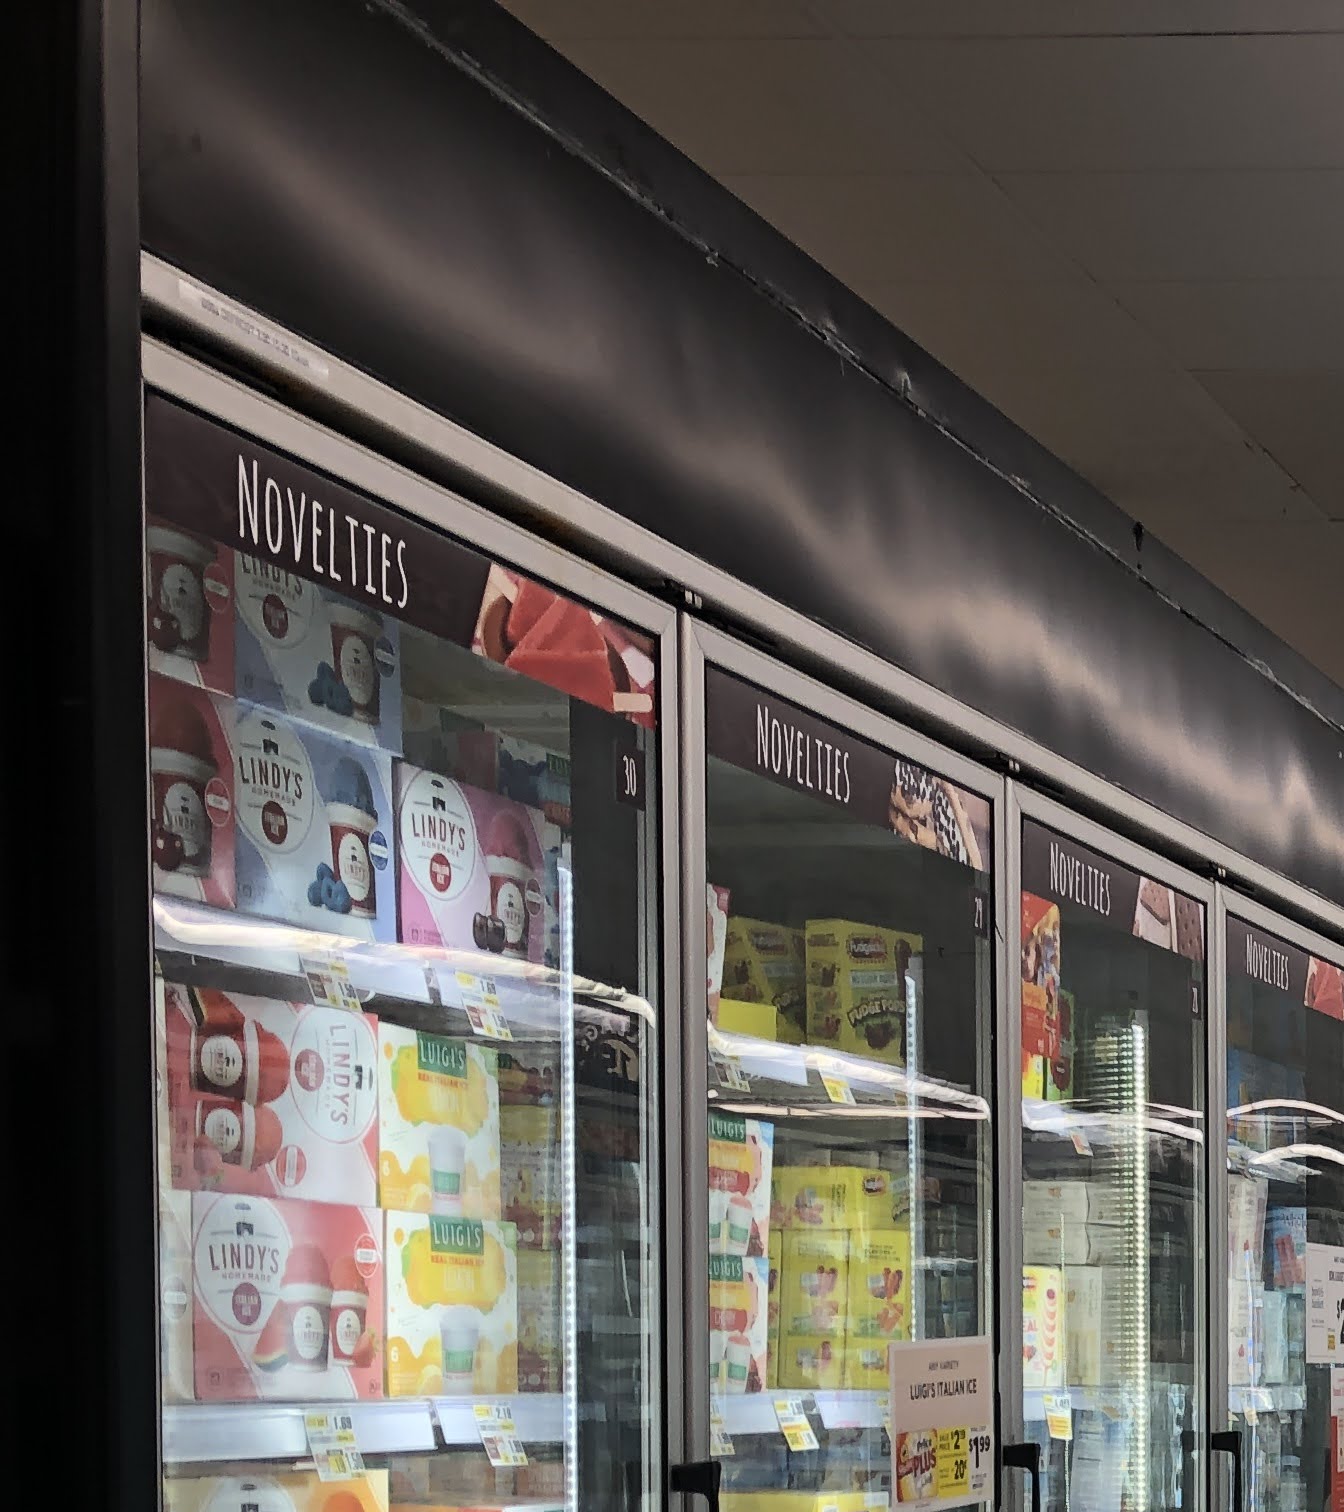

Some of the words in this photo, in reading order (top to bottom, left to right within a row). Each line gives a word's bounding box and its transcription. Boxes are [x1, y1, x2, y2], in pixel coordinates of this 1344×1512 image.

[237, 455, 409, 609] NOVELTIES
[756, 704, 851, 804] NOVELTIES
[238, 756, 304, 801] LINDY'S
[622, 755, 637, 797] 30
[411, 813, 466, 851] LINDY'S
[1049, 841, 1112, 917] NOVELTIES
[1244, 933, 1290, 992] NOVELTIES
[848, 1000, 881, 1025] FUDGE
[419, 1034, 467, 1071] LUIGI'S
[329, 1023, 348, 1126] LINDY'S
[710, 1118, 745, 1140] LUIGI'S
[433, 1221, 482, 1250] LUIGI'S
[209, 1244, 280, 1273] LINDY'S
[910, 1382, 936, 1401] LUIGI'S
[937, 1379, 965, 1397] ITALIAN
[966, 1378, 977, 1395] ICE
[912, 1448, 937, 1478] PLUS
